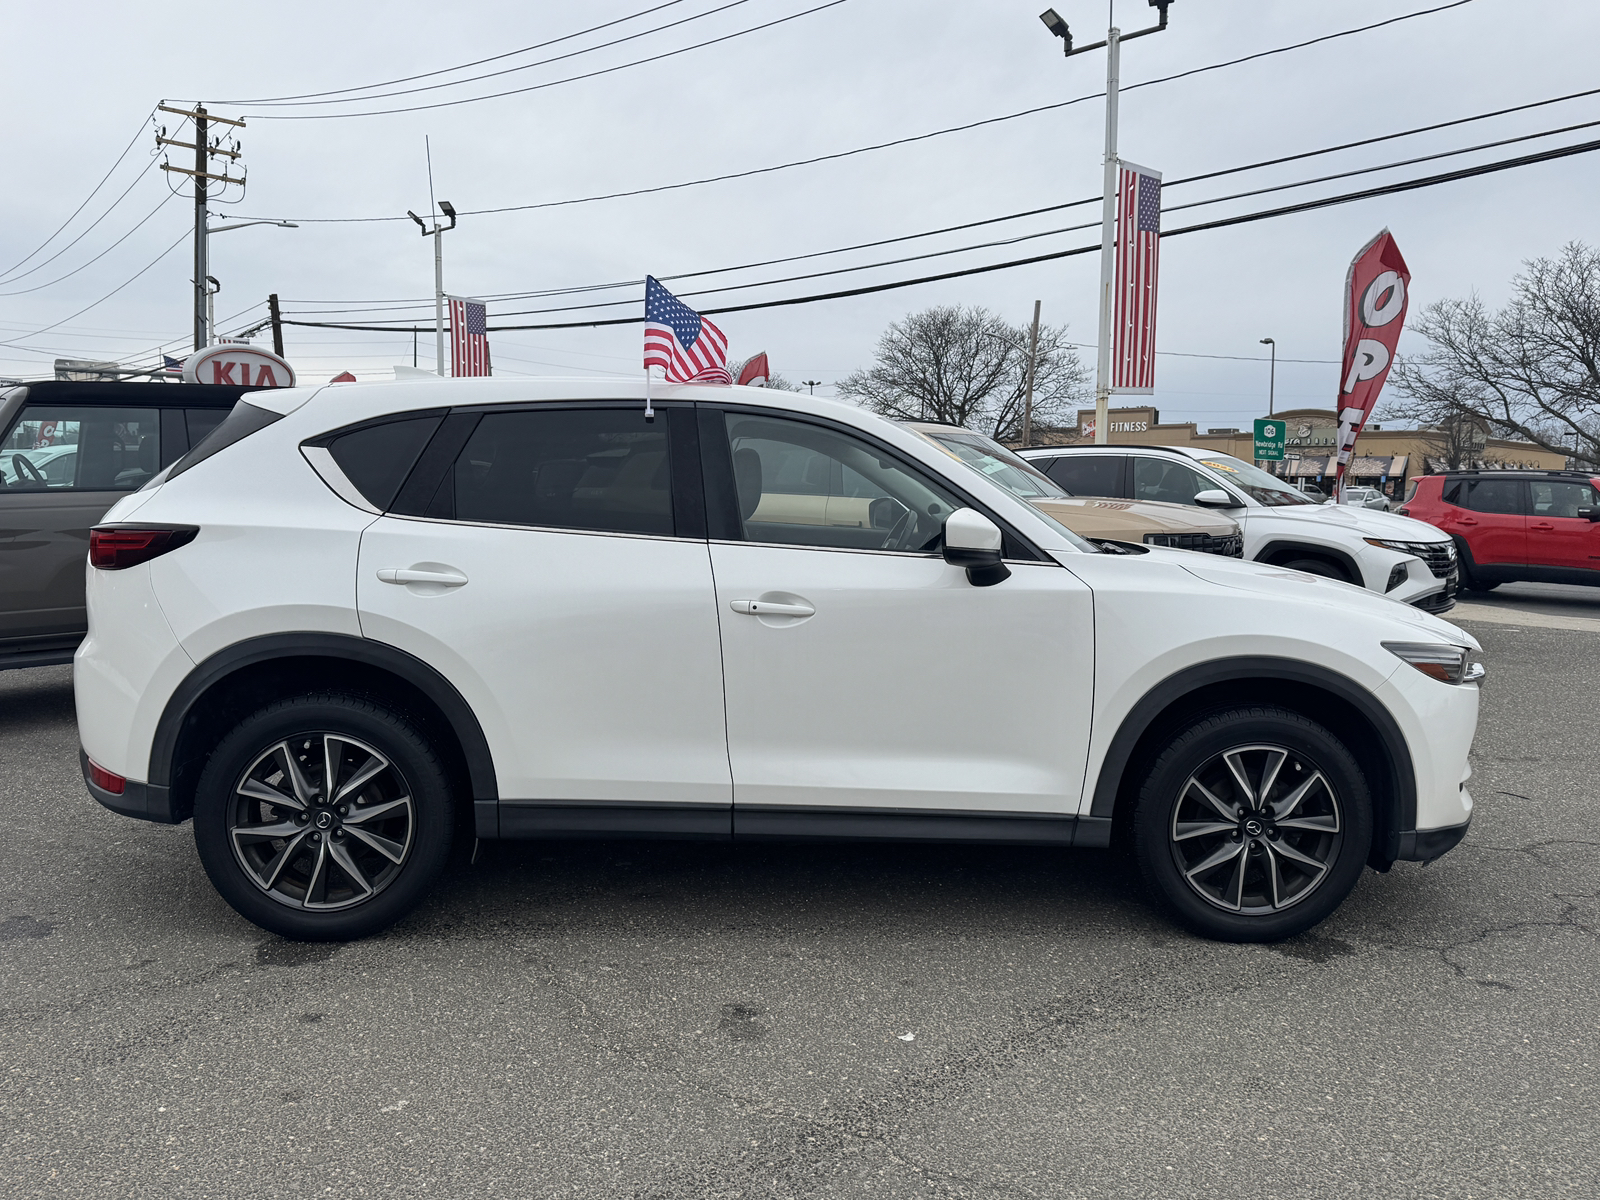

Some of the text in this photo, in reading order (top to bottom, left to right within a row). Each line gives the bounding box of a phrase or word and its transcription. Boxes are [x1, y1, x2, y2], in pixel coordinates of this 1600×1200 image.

[212, 361, 277, 386] KIA
[1110, 422, 1147, 432] FITNESS
[1255, 441, 1276, 449] Newbridge
